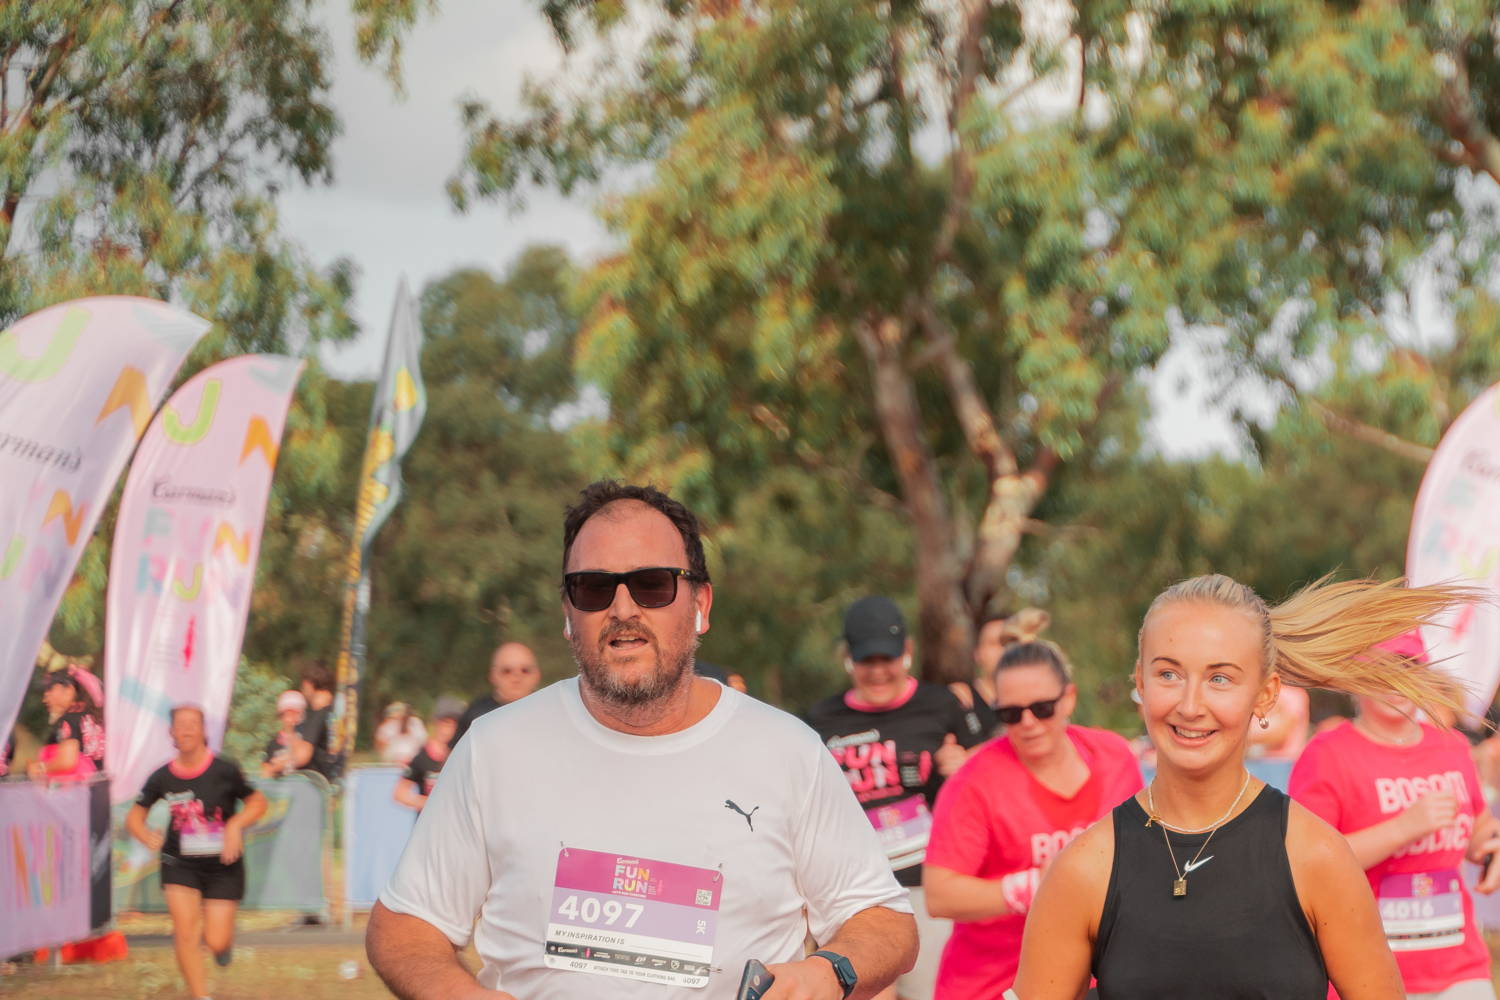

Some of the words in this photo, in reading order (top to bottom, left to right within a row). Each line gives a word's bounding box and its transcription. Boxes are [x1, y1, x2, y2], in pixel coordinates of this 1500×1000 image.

[614, 864, 650, 881] FUN
[612, 877, 649, 894] RUN
[558, 895, 645, 929] 4097
[1382, 900, 1434, 919] 4016
[696, 919, 706, 935] 5K
[567, 931, 616, 944] INSPIRATION
[616, 937, 625, 945] IS
[569, 961, 588, 969] 4097
